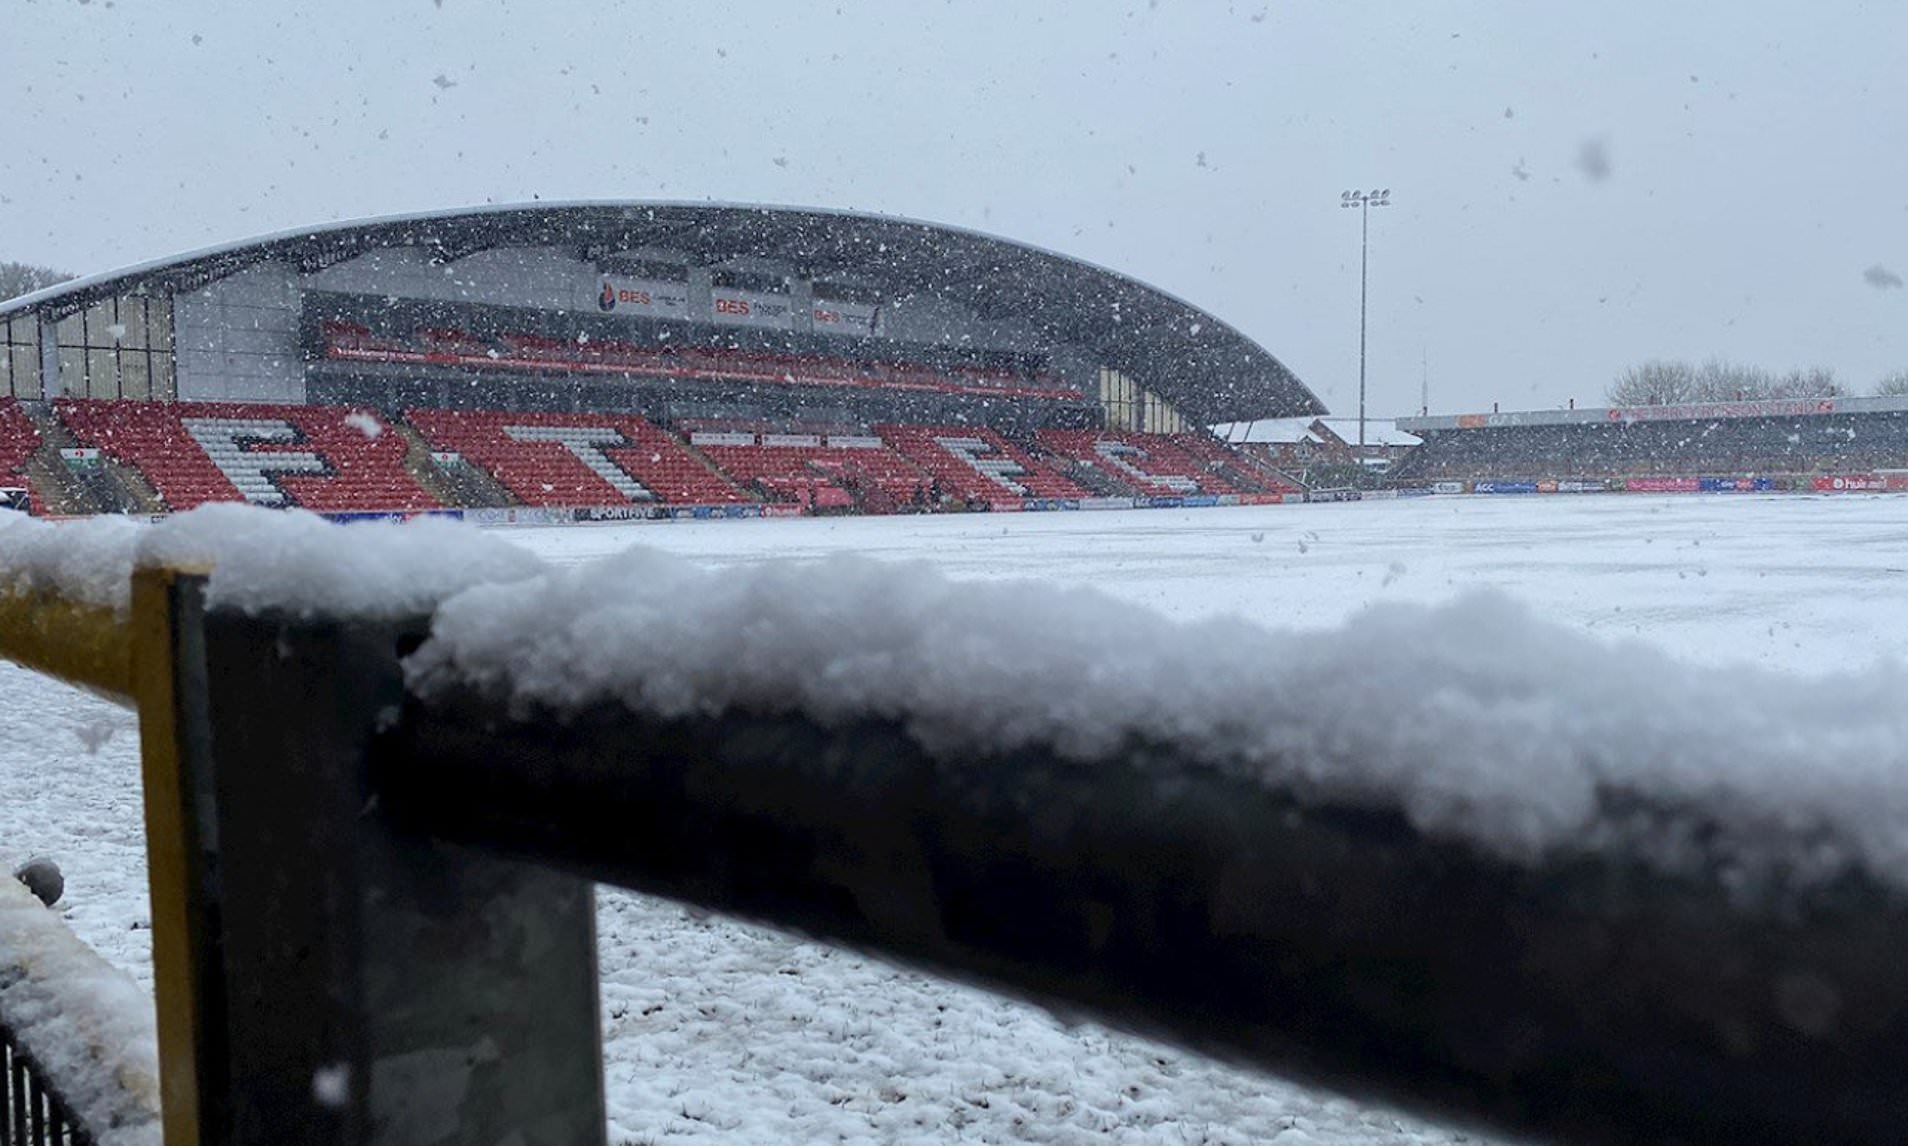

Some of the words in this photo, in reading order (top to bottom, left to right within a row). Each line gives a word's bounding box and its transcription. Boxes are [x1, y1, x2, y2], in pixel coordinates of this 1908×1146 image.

[619, 290, 651, 304] BES
[716, 299, 750, 315] BES
[814, 310, 840, 322] BES
[590, 506, 656, 519] SPORTFIVE
